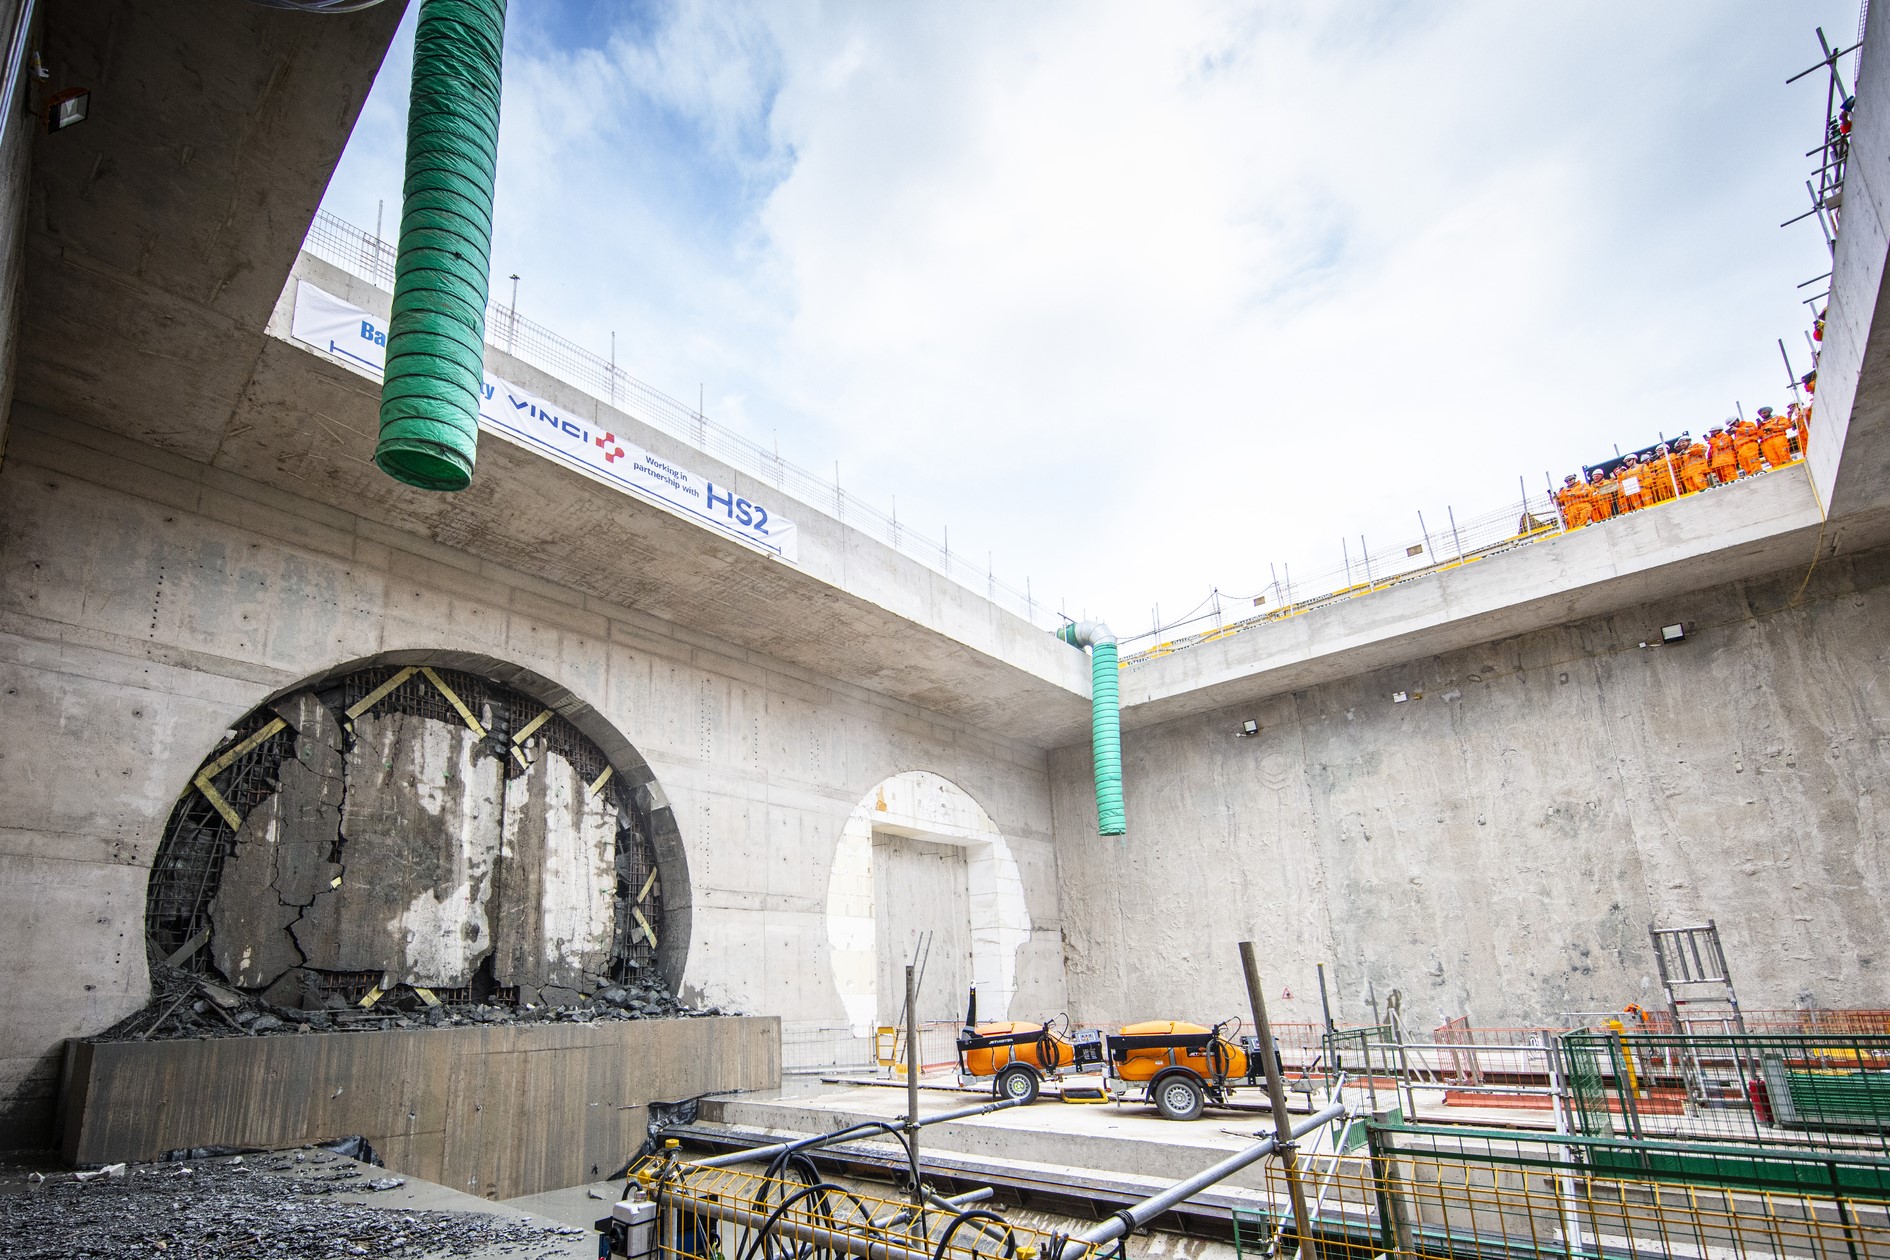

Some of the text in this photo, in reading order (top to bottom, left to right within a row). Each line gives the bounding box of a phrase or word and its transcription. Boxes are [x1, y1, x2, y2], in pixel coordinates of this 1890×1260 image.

[361, 320, 386, 348] Ba
[507, 394, 589, 443] VINCI
[633, 462, 699, 498] partnership with
[645, 455, 688, 481] Working in
[706, 482, 769, 535] HS2
